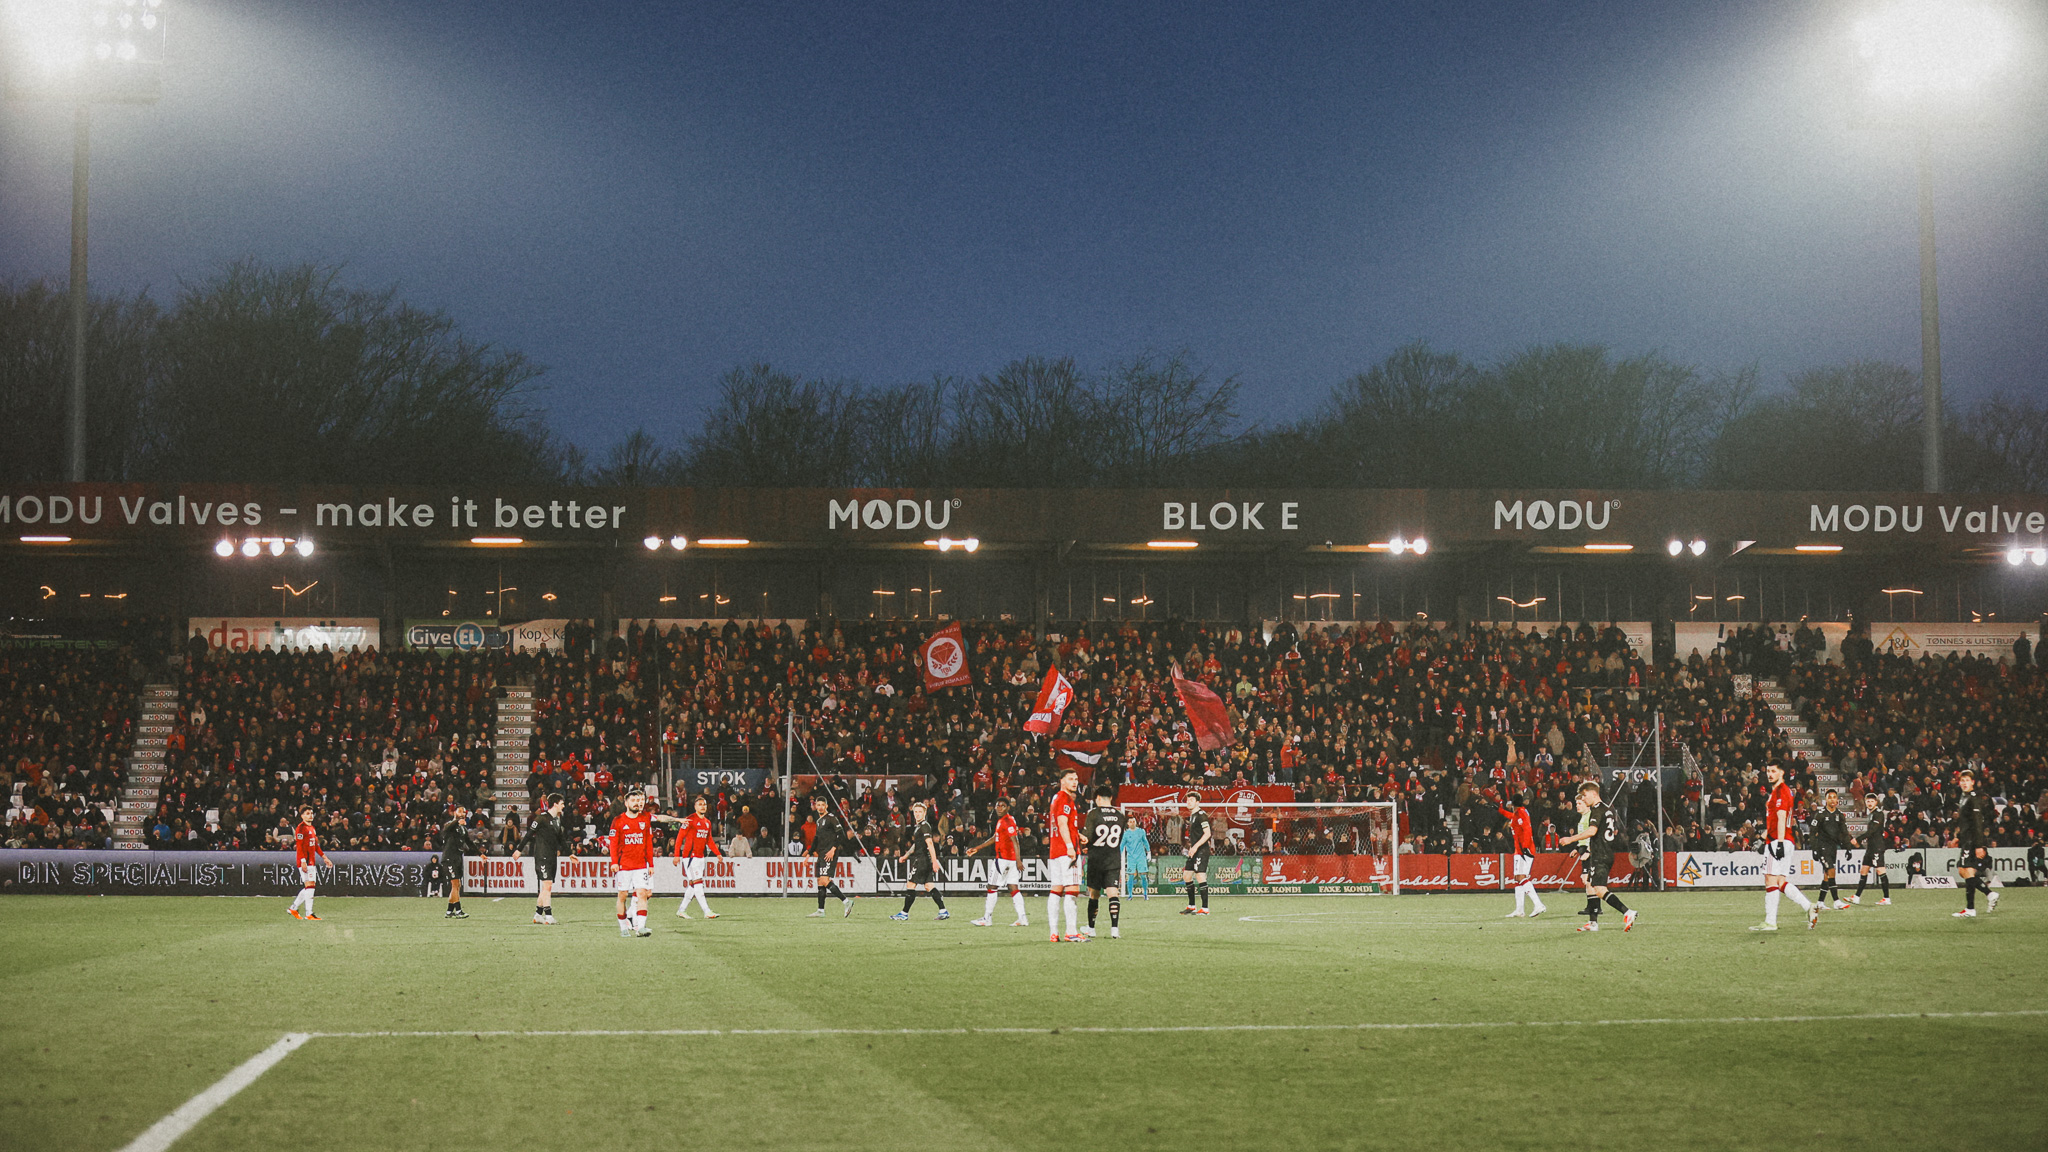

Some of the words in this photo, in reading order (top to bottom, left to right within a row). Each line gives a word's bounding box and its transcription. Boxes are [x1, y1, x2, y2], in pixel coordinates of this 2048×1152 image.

[118, 495, 262, 526] Valves
[316, 497, 434, 528] make
[452, 496, 478, 528] it
[495, 498, 626, 529] better
[1164, 502, 1264, 530] BLOK
[1282, 502, 1298, 530] E
[1810, 504, 1924, 532] MODU
[1938, 504, 2046, 533] Valve
[412, 628, 452, 645] Give
[1888, 638, 1910, 648] T&U
[1093, 824, 1122, 848] 28
[18, 861, 62, 885] DIN
[72, 861, 235, 886] SPECIALIST
[468, 861, 524, 877] UNIBOX
[767, 879, 854, 888] TRANSRT
